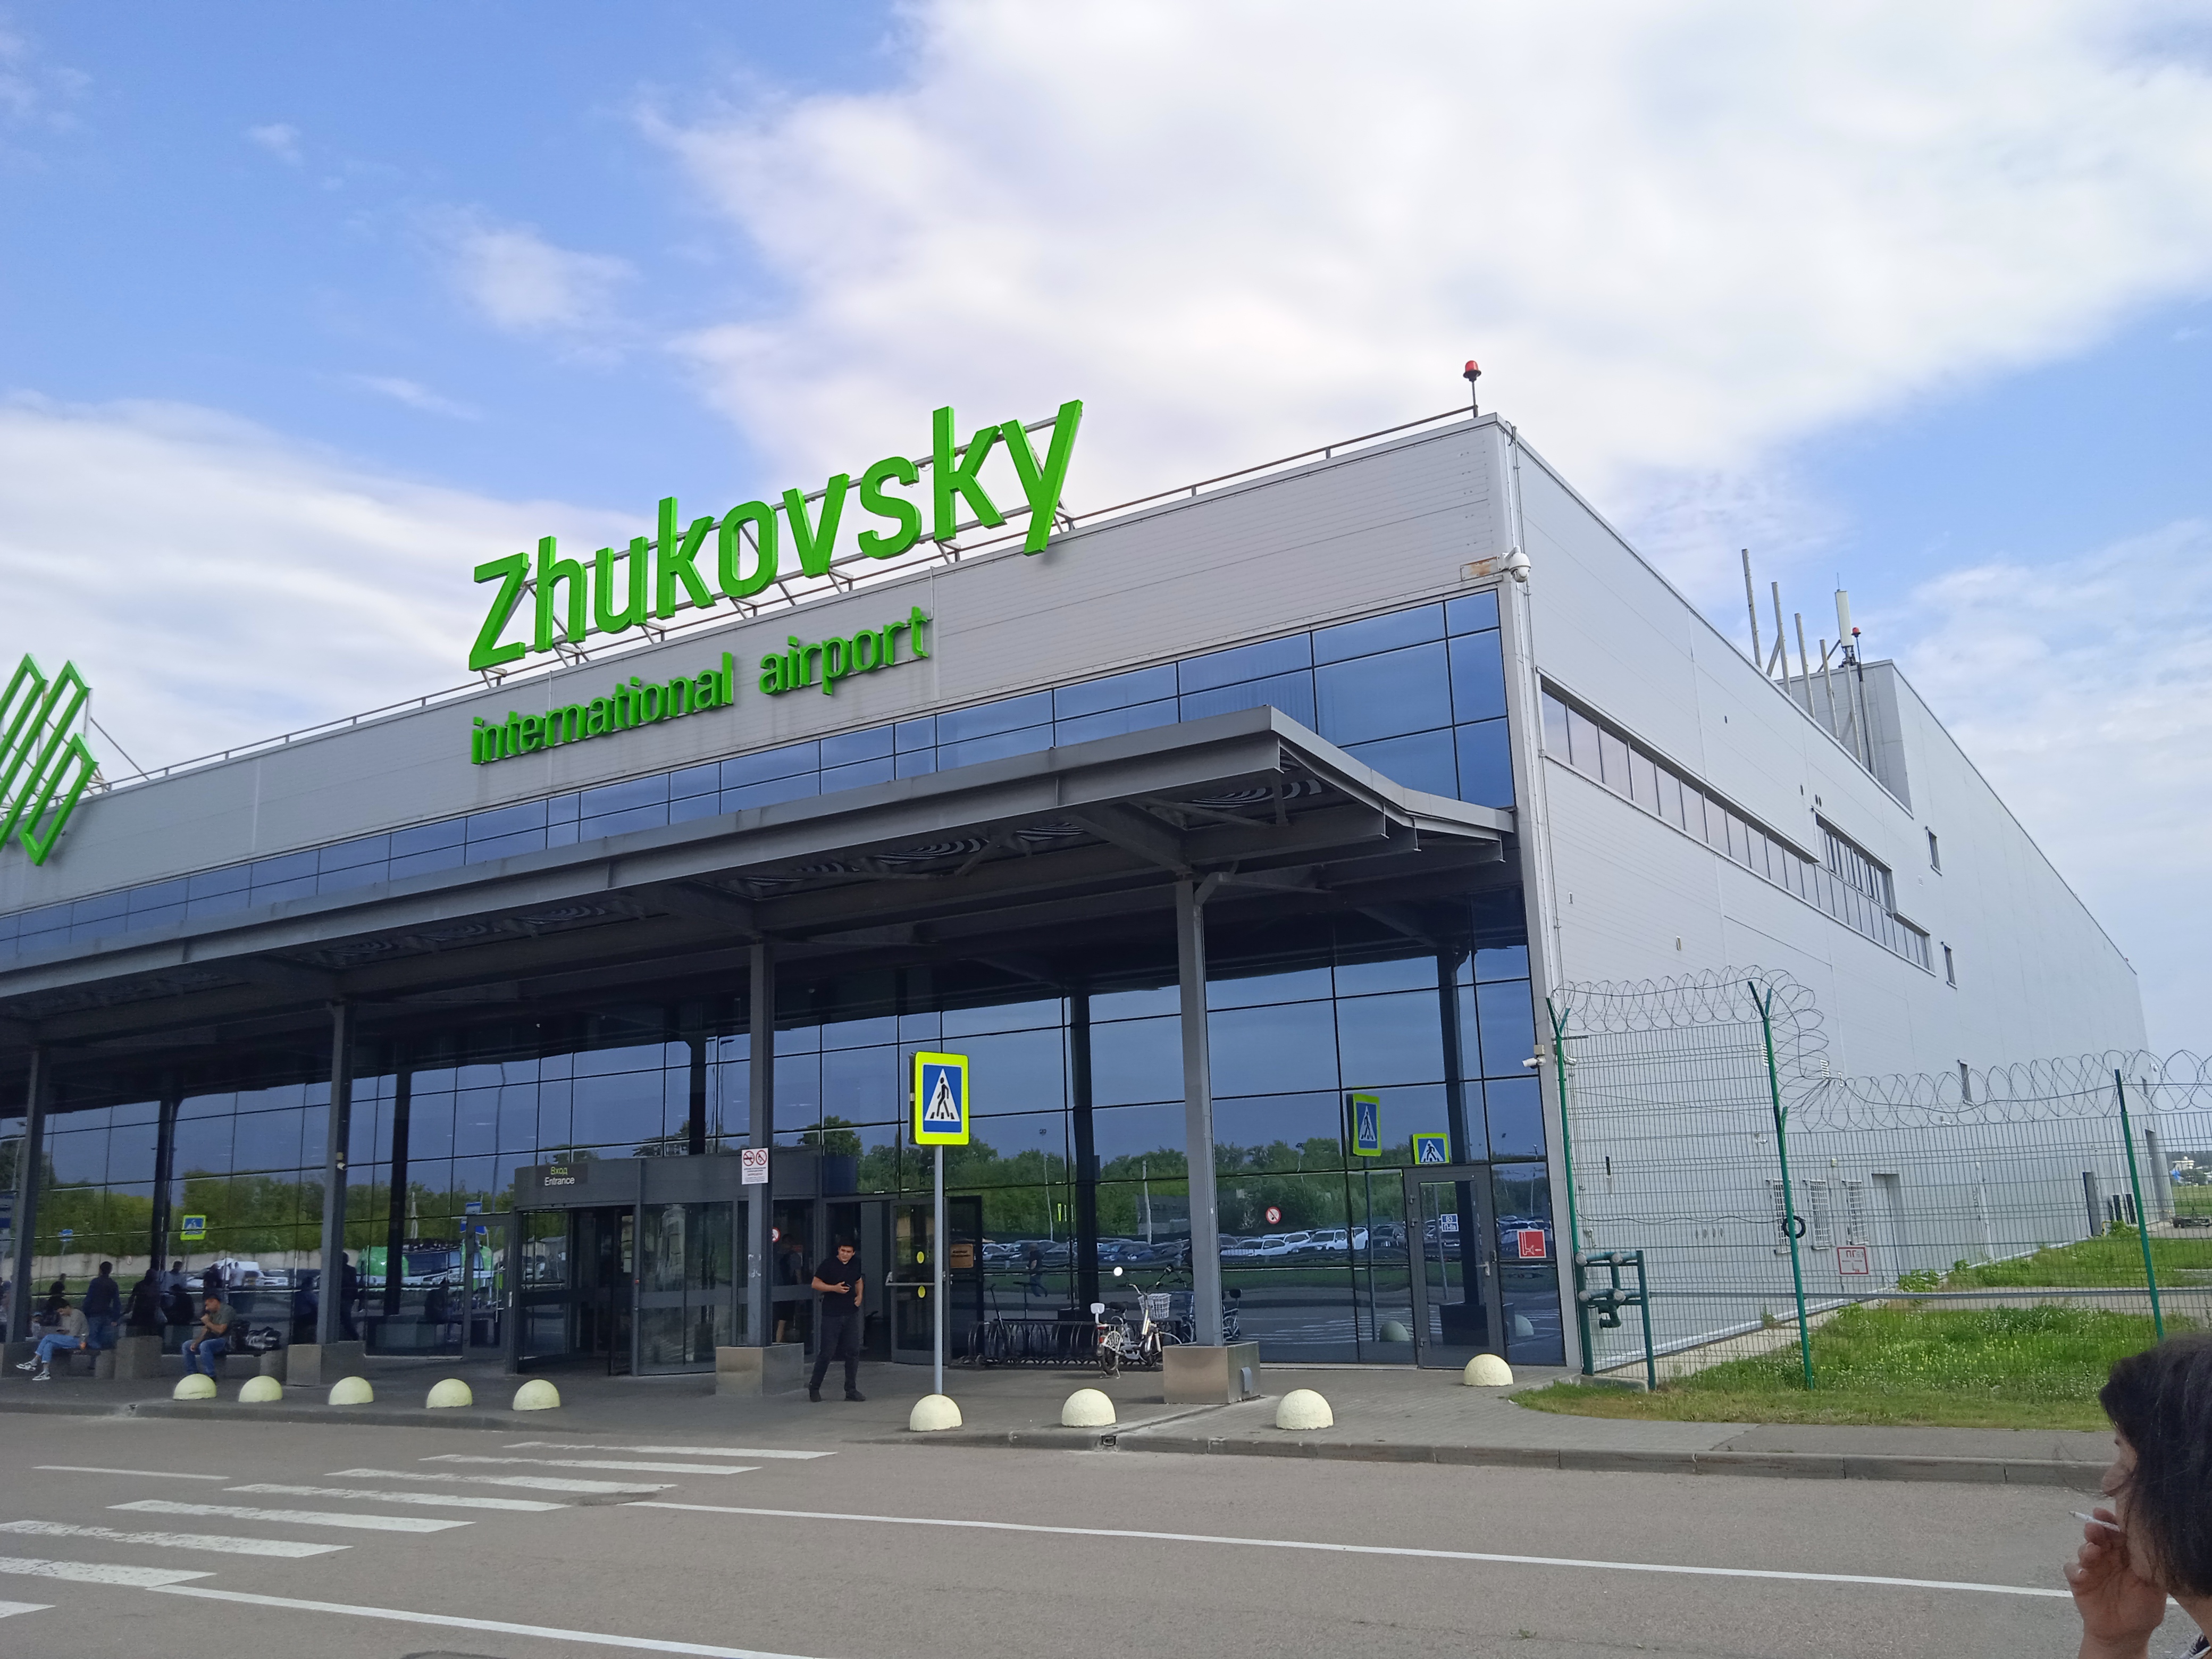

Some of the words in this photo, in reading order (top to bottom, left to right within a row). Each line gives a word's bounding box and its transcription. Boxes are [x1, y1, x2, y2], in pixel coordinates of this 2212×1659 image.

[468, 399, 1084, 671] Zhukovsky
[471, 651, 734, 765] international
[758, 606, 929, 696] airport
[544, 1177, 575, 1186] Entrance
[550, 1166, 568, 1176] Вход
